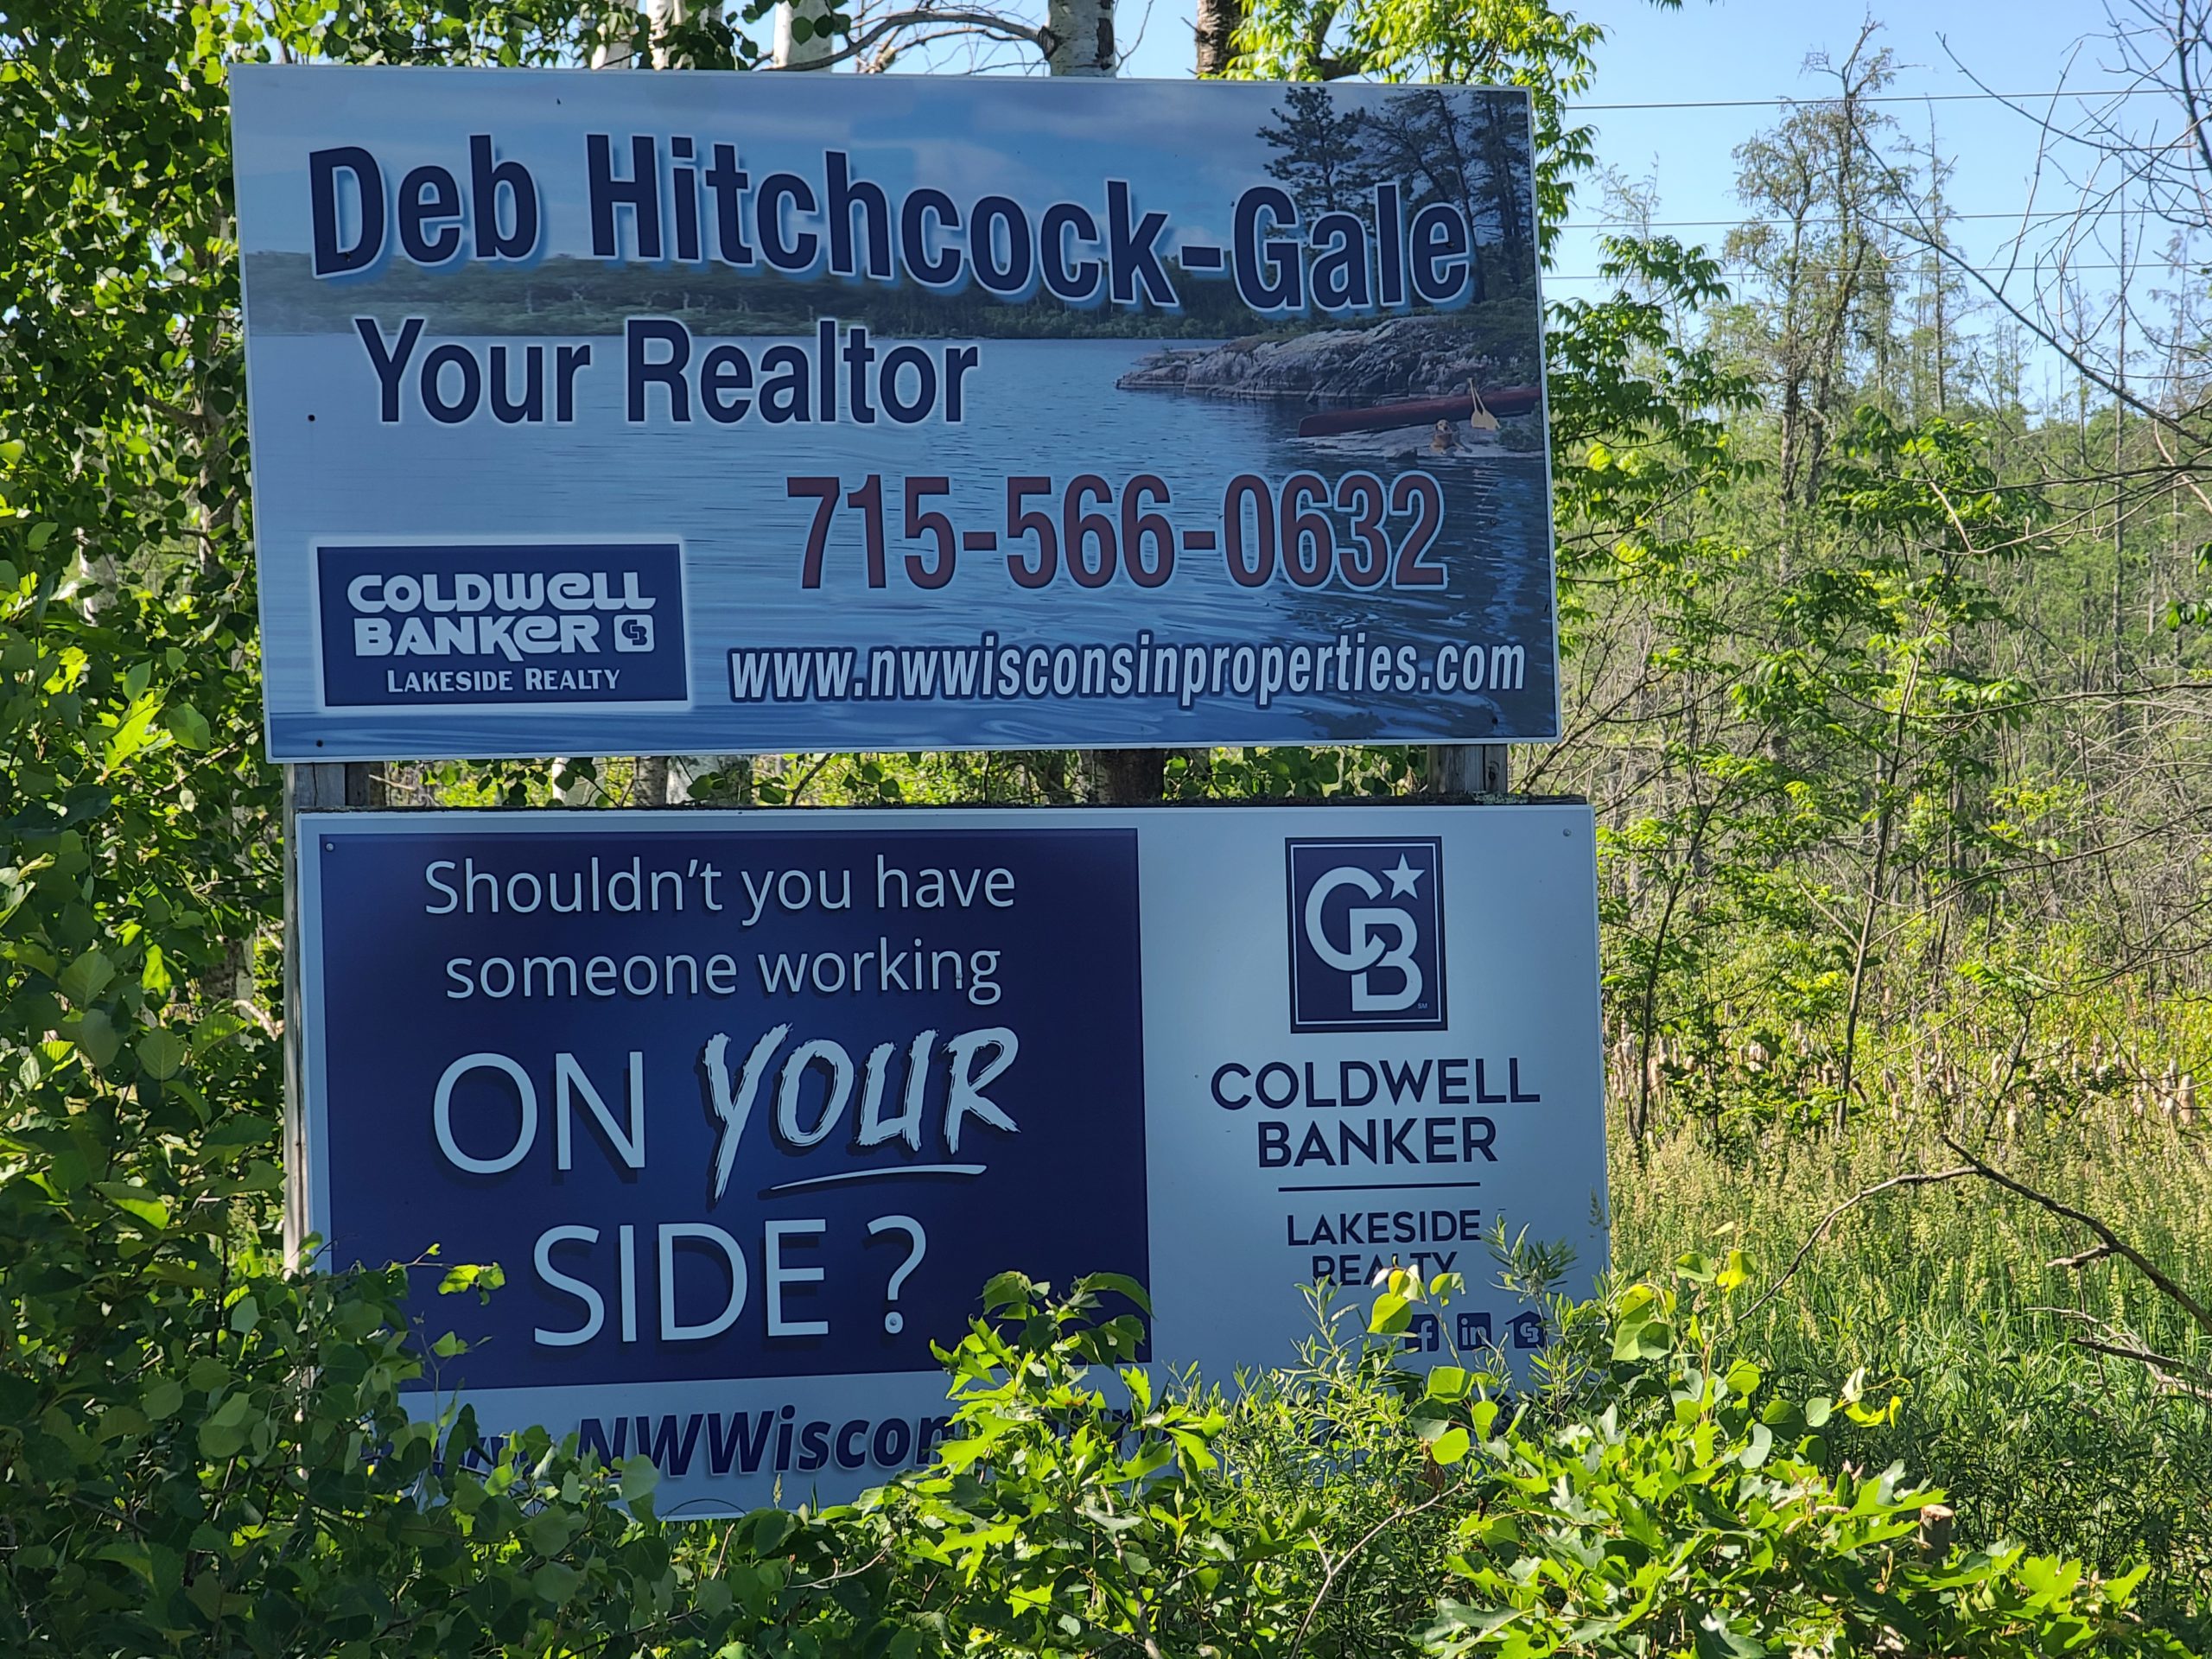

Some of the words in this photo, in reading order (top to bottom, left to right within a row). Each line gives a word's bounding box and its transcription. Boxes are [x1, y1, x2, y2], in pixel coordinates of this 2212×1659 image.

[308, 133, 539, 277] Deb
[586, 133, 1471, 311] Hitchcock-Gale
[353, 317, 592, 424] Your
[626, 318, 979, 424] Realtor
[785, 472, 1447, 592] 715-566-0632
[387, 669, 514, 693] LAKESIDE
[524, 668, 620, 691] REALTY
[729, 630, 1527, 708] www.nwwisconsinproperties.com
[423, 855, 723, 915] Shouldn't
[740, 868, 853, 927] you
[875, 854, 1016, 909] have
[445, 950, 737, 1000] someone
[757, 937, 1001, 1006] working
[1304, 866, 1423, 1013] CB
[433, 1051, 646, 1174] ON
[702, 1022, 1022, 1203] YOUR
[1211, 1057, 1541, 1111] COLDWELL
[1257, 1116, 1499, 1168] BANKER
[1287, 1209, 1482, 1247] LAKESIDE
[532, 1218, 830, 1346] SIDE
